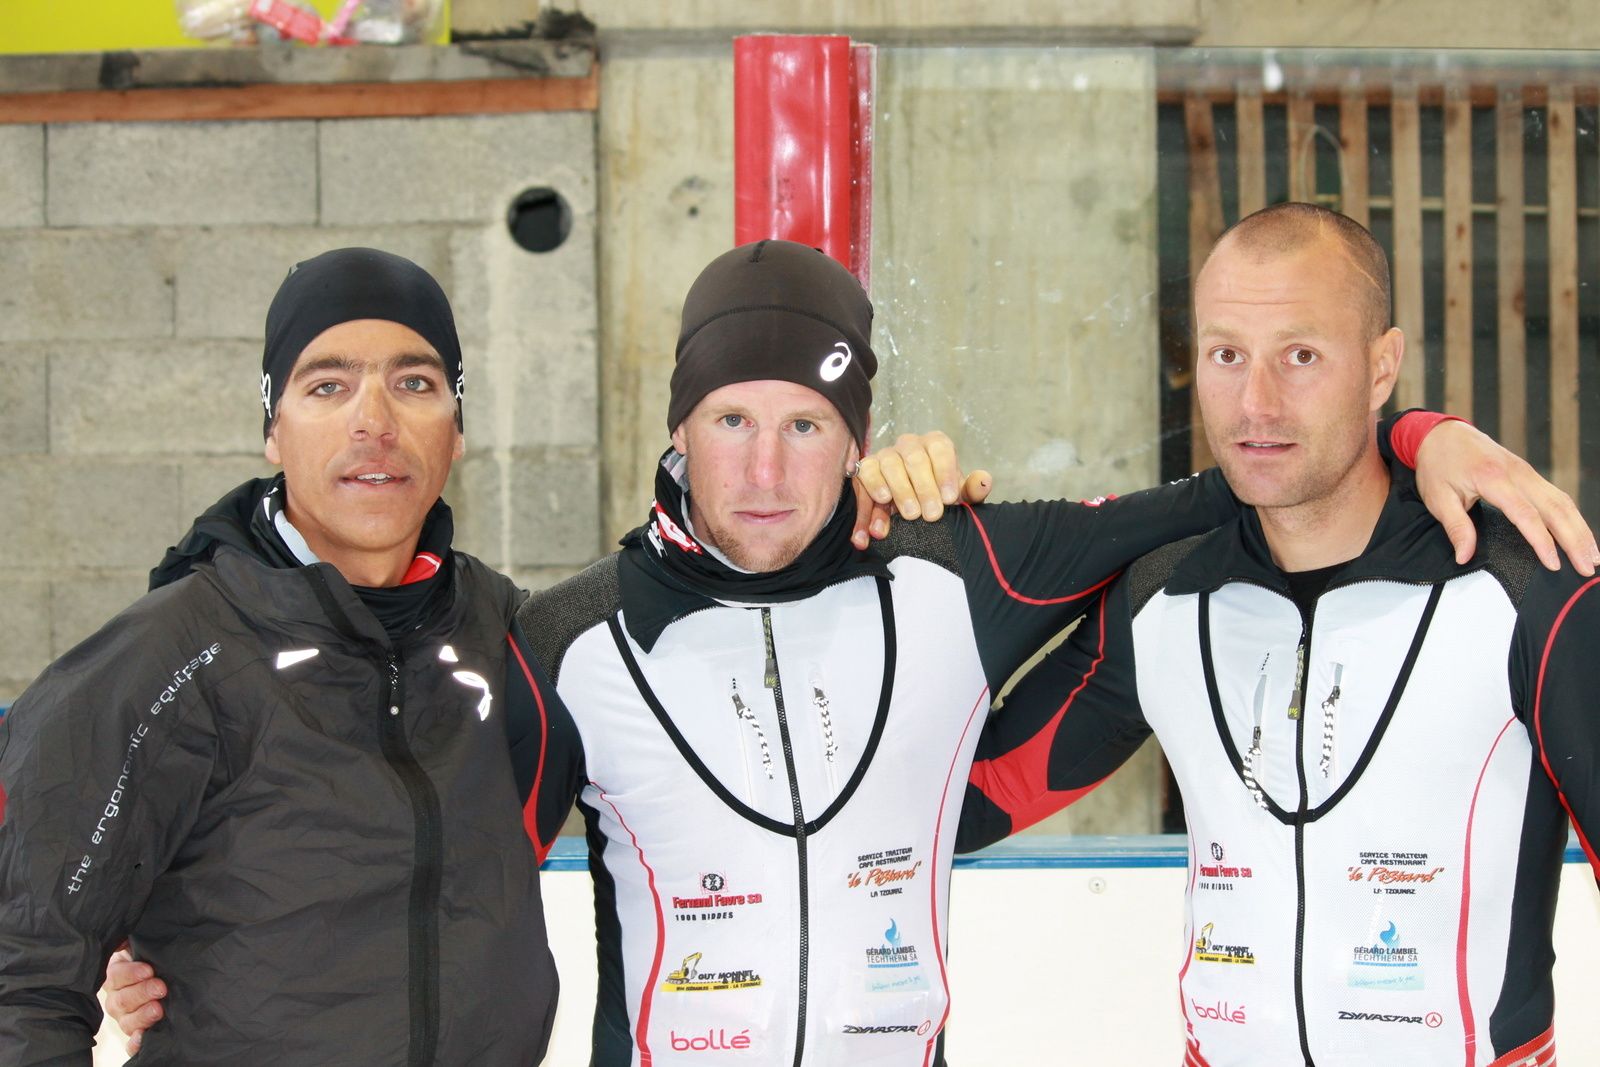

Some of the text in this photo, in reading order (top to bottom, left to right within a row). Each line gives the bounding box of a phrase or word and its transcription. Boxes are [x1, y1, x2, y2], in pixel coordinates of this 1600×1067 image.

[67, 855, 92, 894] the
[91, 723, 148, 844] ergonomic
[1354, 946, 1385, 954] GÉRARD
[1354, 953, 1404, 962] TECHTHERM
[1192, 999, 1246, 1024] bollé
[1338, 1011, 1423, 1024] DYNASTAR
[842, 1024, 918, 1034] DYNASTAR
[671, 1029, 750, 1051] bollé
